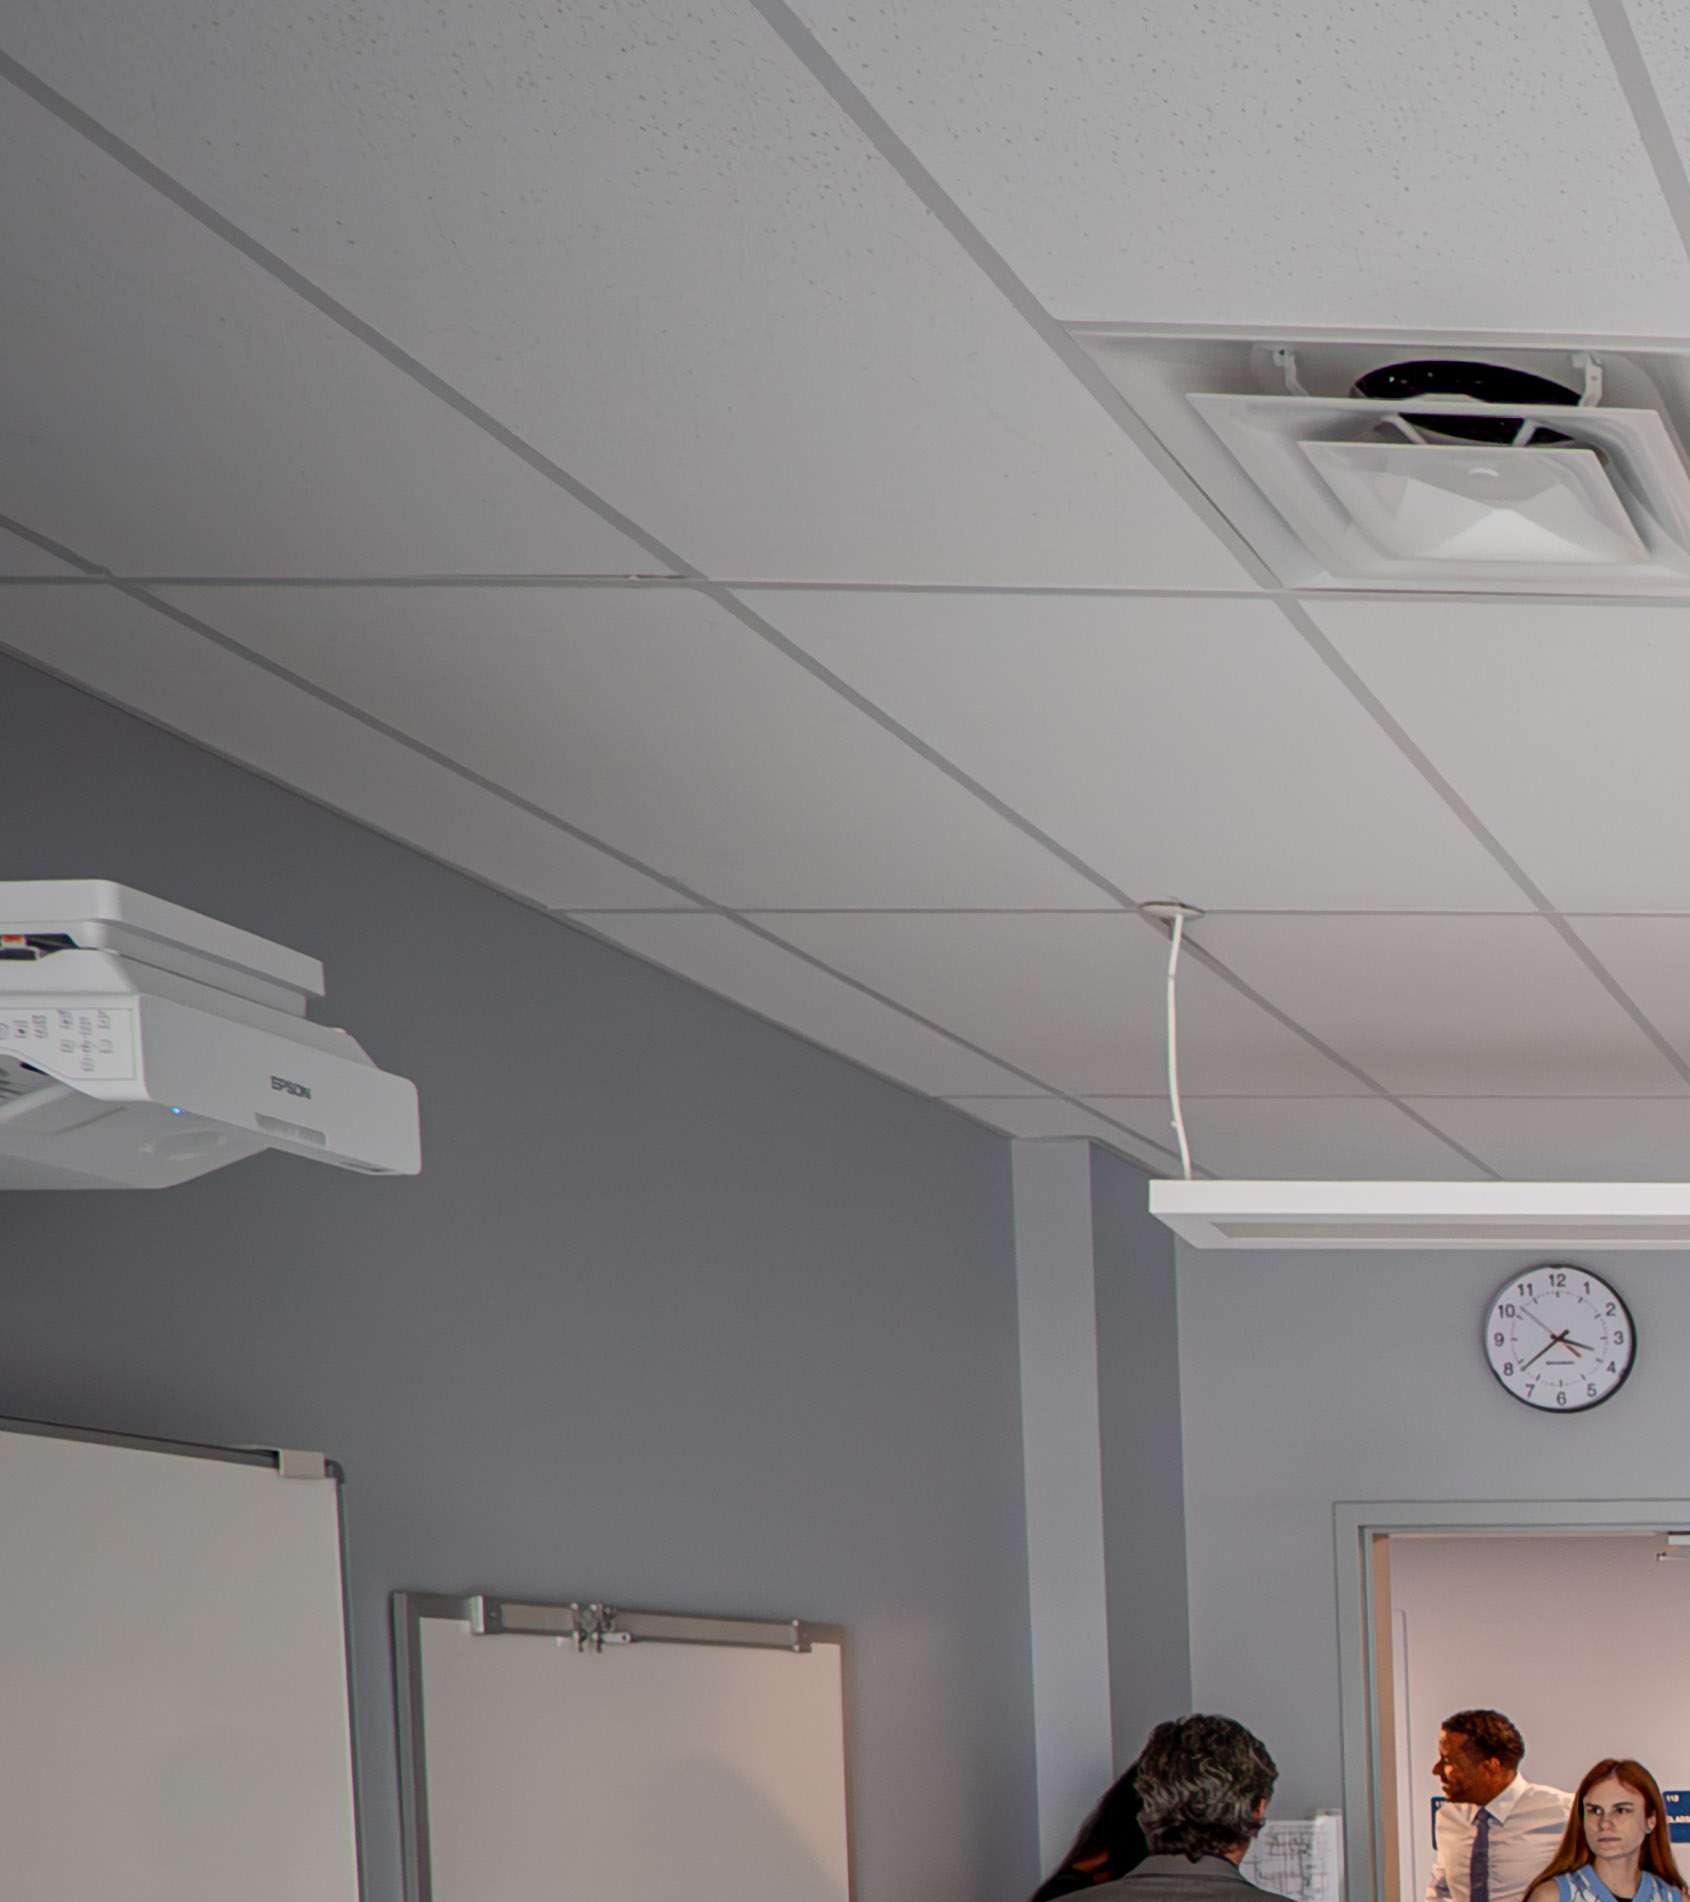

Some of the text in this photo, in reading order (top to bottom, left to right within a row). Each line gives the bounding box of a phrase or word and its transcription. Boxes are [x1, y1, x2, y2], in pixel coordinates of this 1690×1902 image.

[270, 1075, 312, 1100] EPSON
[1548, 1273, 1567, 1288] 12
[1583, 1281, 1591, 1295] 1
[1517, 1283, 1534, 1297] 11
[1498, 1304, 1516, 1319] 10
[1605, 1302, 1617, 1317] 2
[1494, 1332, 1505, 1347] 9
[1613, 1331, 1624, 1345] 3
[1503, 1362, 1514, 1376] 8
[1606, 1361, 1616, 1374] 4
[1525, 1383, 1536, 1398] 7
[1587, 1383, 1597, 1398] 5
[1556, 1392, 1567, 1406] 6
